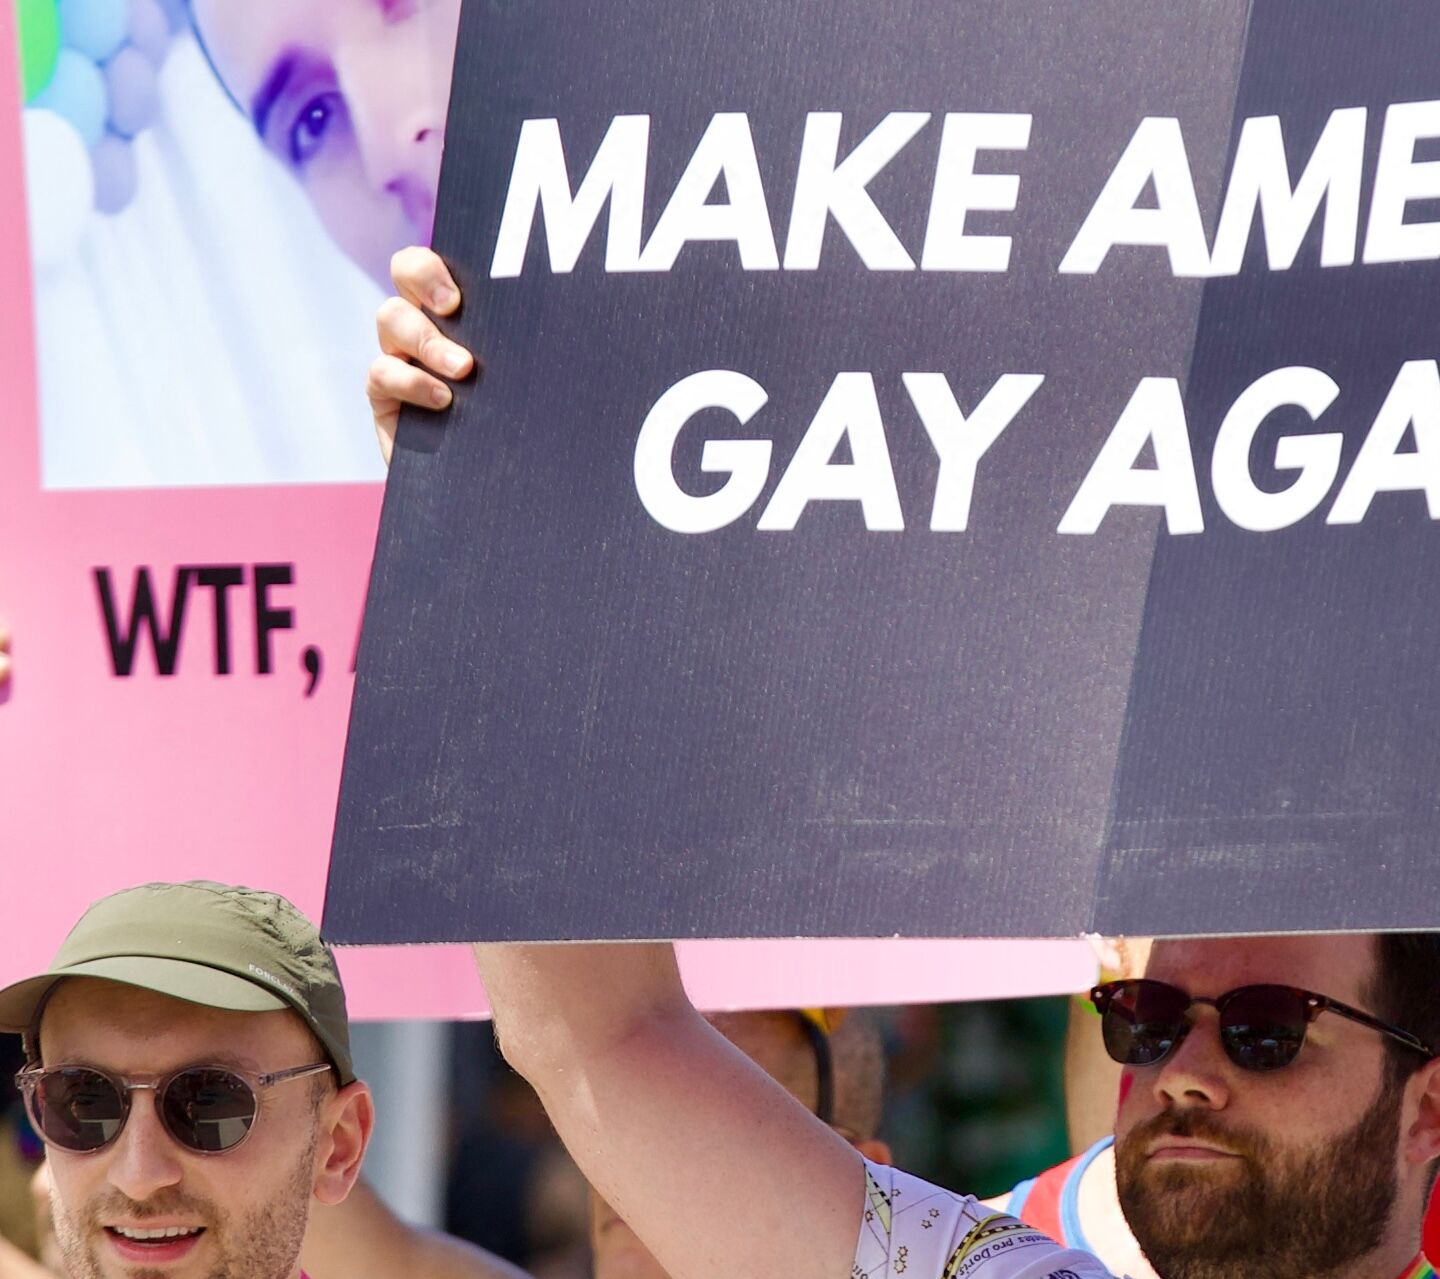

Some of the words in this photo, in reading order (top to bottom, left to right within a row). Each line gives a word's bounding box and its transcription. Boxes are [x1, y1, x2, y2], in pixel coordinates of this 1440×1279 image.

[490, 111, 1032, 278] MAKE
[633, 369, 1045, 535] GAY
[90, 561, 324, 700] WTF,
